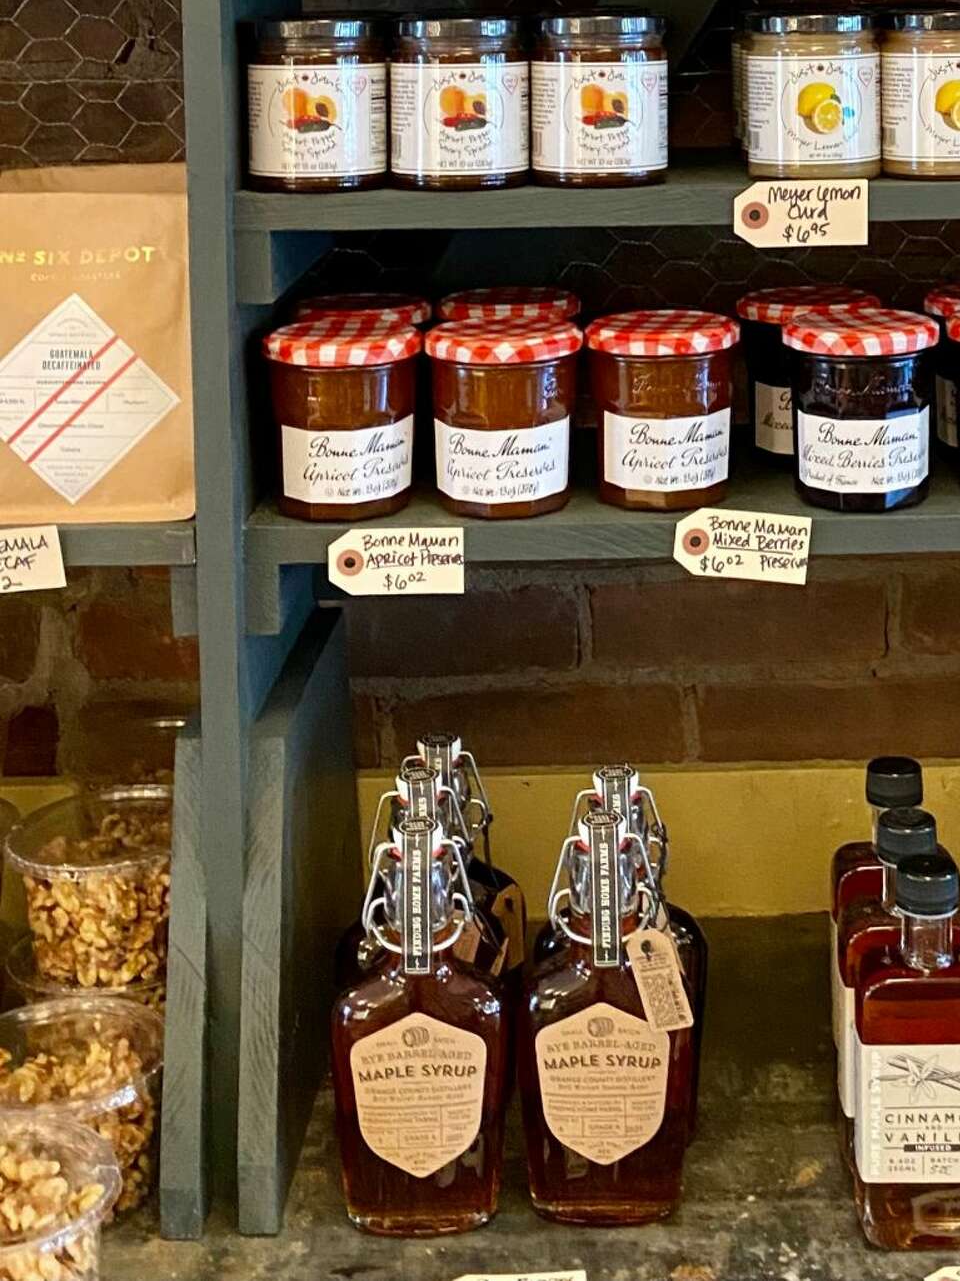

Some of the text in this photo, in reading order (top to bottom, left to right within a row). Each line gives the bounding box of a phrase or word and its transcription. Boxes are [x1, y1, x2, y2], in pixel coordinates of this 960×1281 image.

[768, 186, 816, 206] Meyer
[787, 200, 828, 220] Curd
[33, 249, 70, 265] SIX
[629, 422, 724, 445] Bonne Maman
[818, 421, 919, 447] Bonne Maman
[308, 436, 358, 458] Bonne
[450, 433, 550, 458] Bonne Maman
[622, 449, 675, 471] Apricot
[837, 449, 885, 470] Berries
[708, 515, 751, 532] Bonne
[0, 534, 48, 553] EMALA
[362, 534, 406, 550] Bonne
[712, 534, 804, 551] Mixed Berries
[544, 1054, 662, 1070] MAPLE SYRUP
[359, 1064, 478, 1083] MAPLE SYRUP
